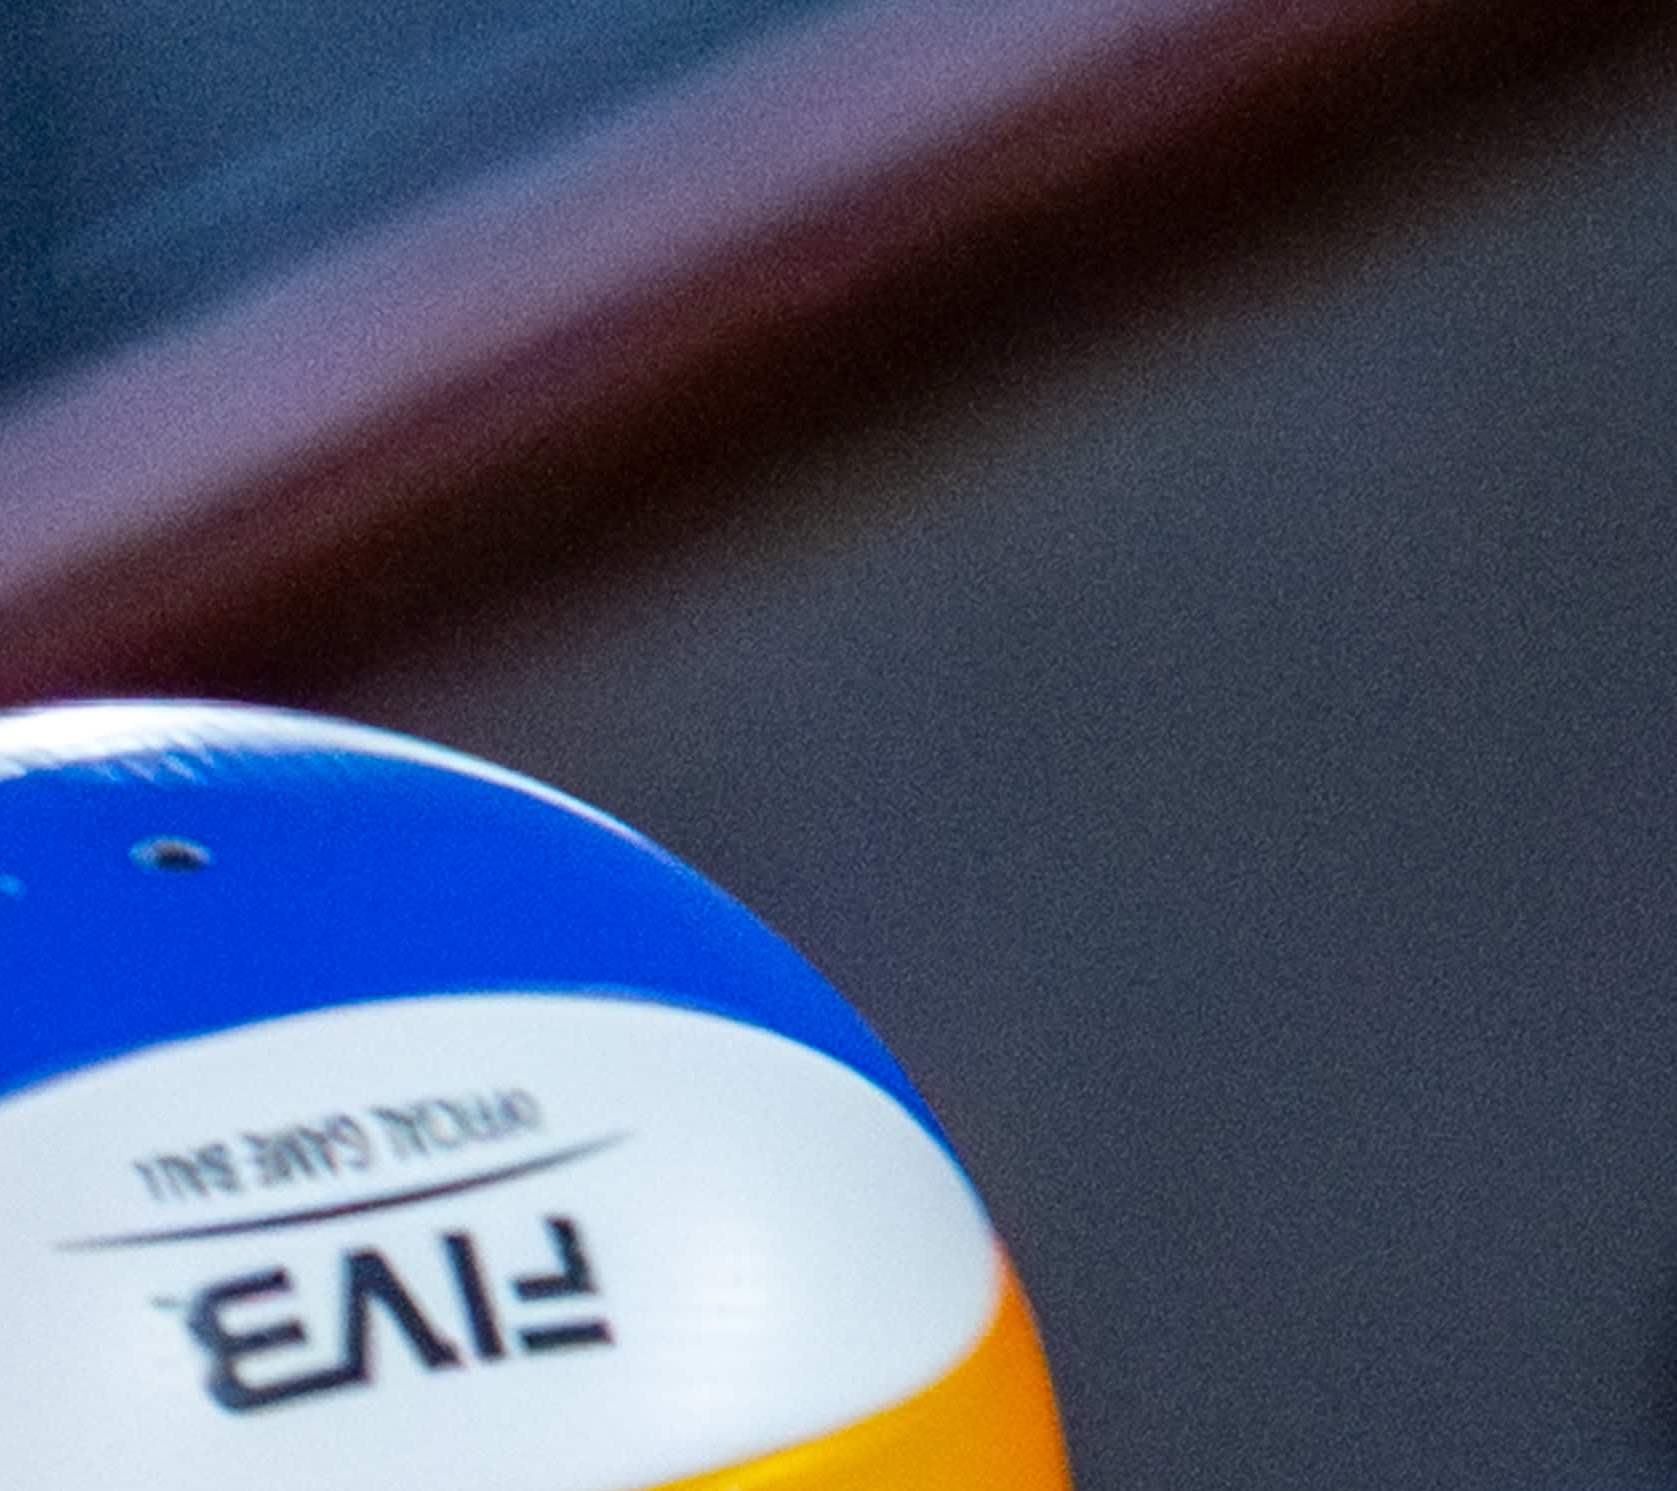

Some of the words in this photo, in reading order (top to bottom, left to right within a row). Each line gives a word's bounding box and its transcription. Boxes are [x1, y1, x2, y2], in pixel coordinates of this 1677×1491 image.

[130, 1141, 245, 1206] BALL
[241, 1113, 375, 1187] GAME
[182, 1216, 615, 1418] FIVB
